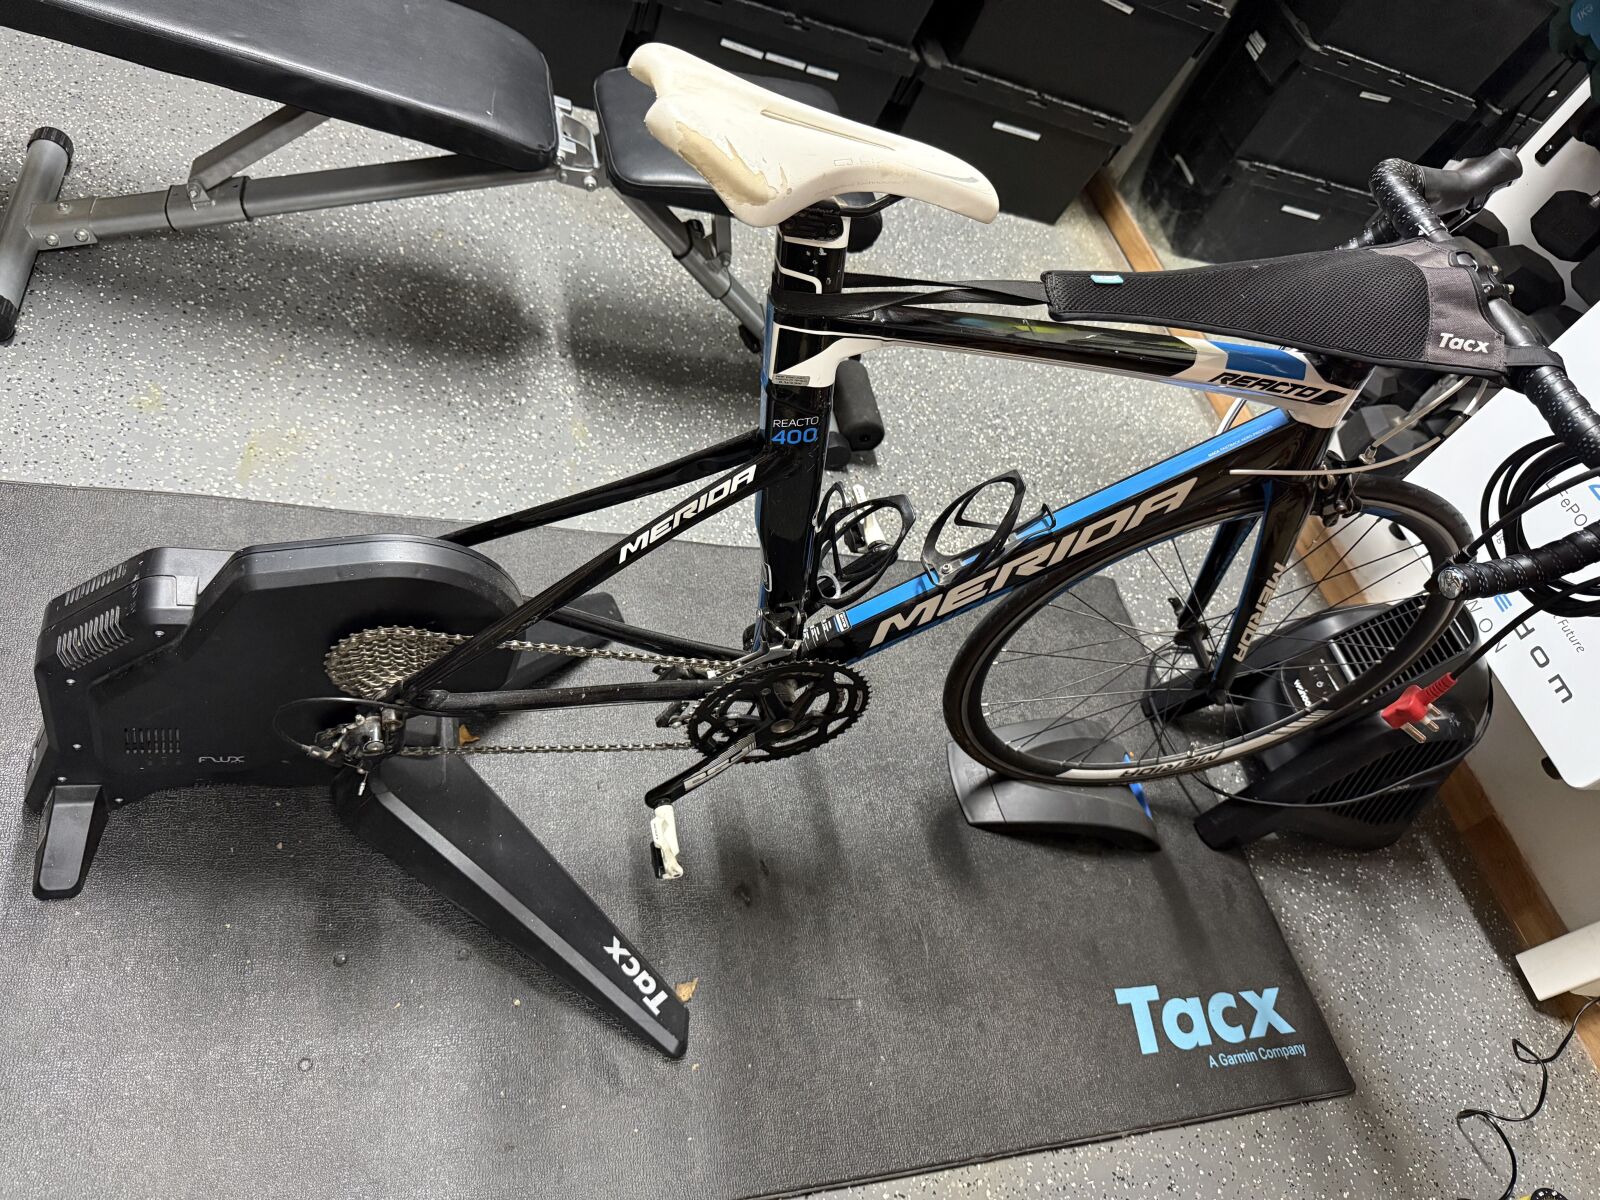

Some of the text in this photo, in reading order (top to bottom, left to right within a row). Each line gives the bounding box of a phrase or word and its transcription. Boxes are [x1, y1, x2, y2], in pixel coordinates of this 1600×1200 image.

[1439, 332, 1490, 354] Tacx
[1207, 372, 1323, 398] REACTO
[771, 427, 818, 445] 400
[772, 415, 819, 428] REACTO
[618, 464, 757, 565] MERIDA
[869, 476, 1199, 648] MERIDA
[1232, 561, 1286, 662] MERIDA
[1557, 619, 1585, 653] Future
[1118, 749, 1223, 779] MERIDA
[602, 935, 669, 1017] Tacx
[1114, 984, 1297, 1055] Tacx
[1208, 1042, 1306, 1069] A Garmin Company
